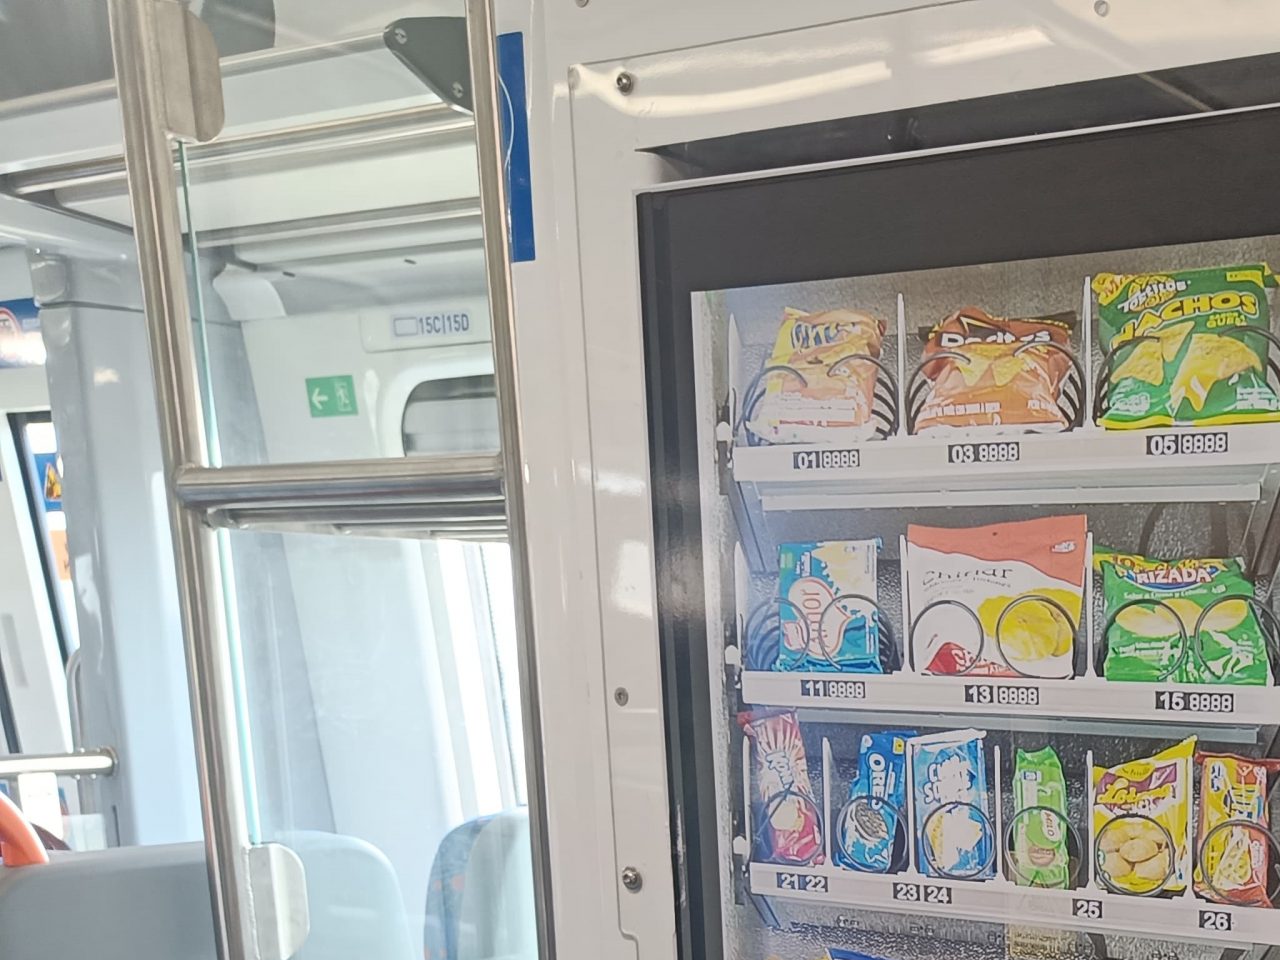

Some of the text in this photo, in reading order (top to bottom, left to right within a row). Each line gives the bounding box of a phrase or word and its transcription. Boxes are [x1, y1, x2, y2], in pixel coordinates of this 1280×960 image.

[1150, 436, 1176, 454] 05
[798, 453, 815, 469] 01
[951, 445, 975, 463] 03
[805, 681, 824, 697] 11
[969, 686, 991, 702] 13
[1159, 692, 1185, 710] 15
[781, 873, 799, 889] 21
[805, 875, 826, 892] 22
[897, 883, 919, 900] 23
[927, 887, 949, 903] 24
[1076, 900, 1100, 918] 25
[1203, 912, 1229, 930] 26
